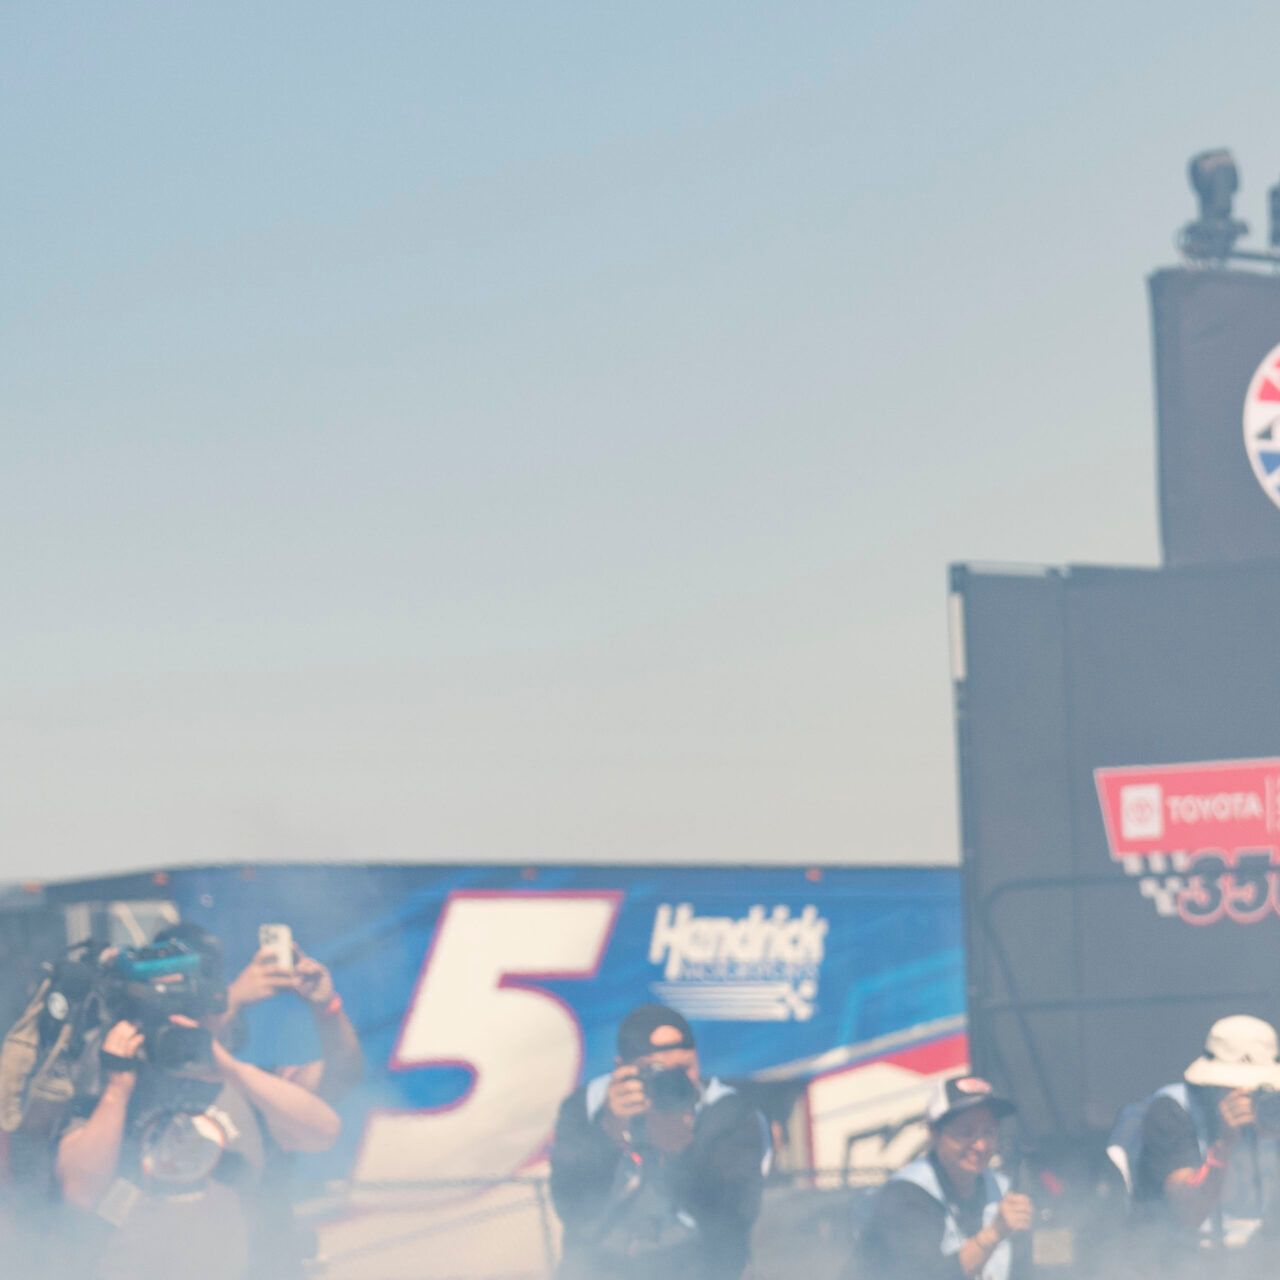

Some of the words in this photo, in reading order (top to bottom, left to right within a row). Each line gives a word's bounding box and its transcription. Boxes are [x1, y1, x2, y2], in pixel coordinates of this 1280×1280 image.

[1165, 793, 1264, 823] TOYOTA
[648, 903, 829, 981] Hendrick
[350, 889, 624, 1190] 5
